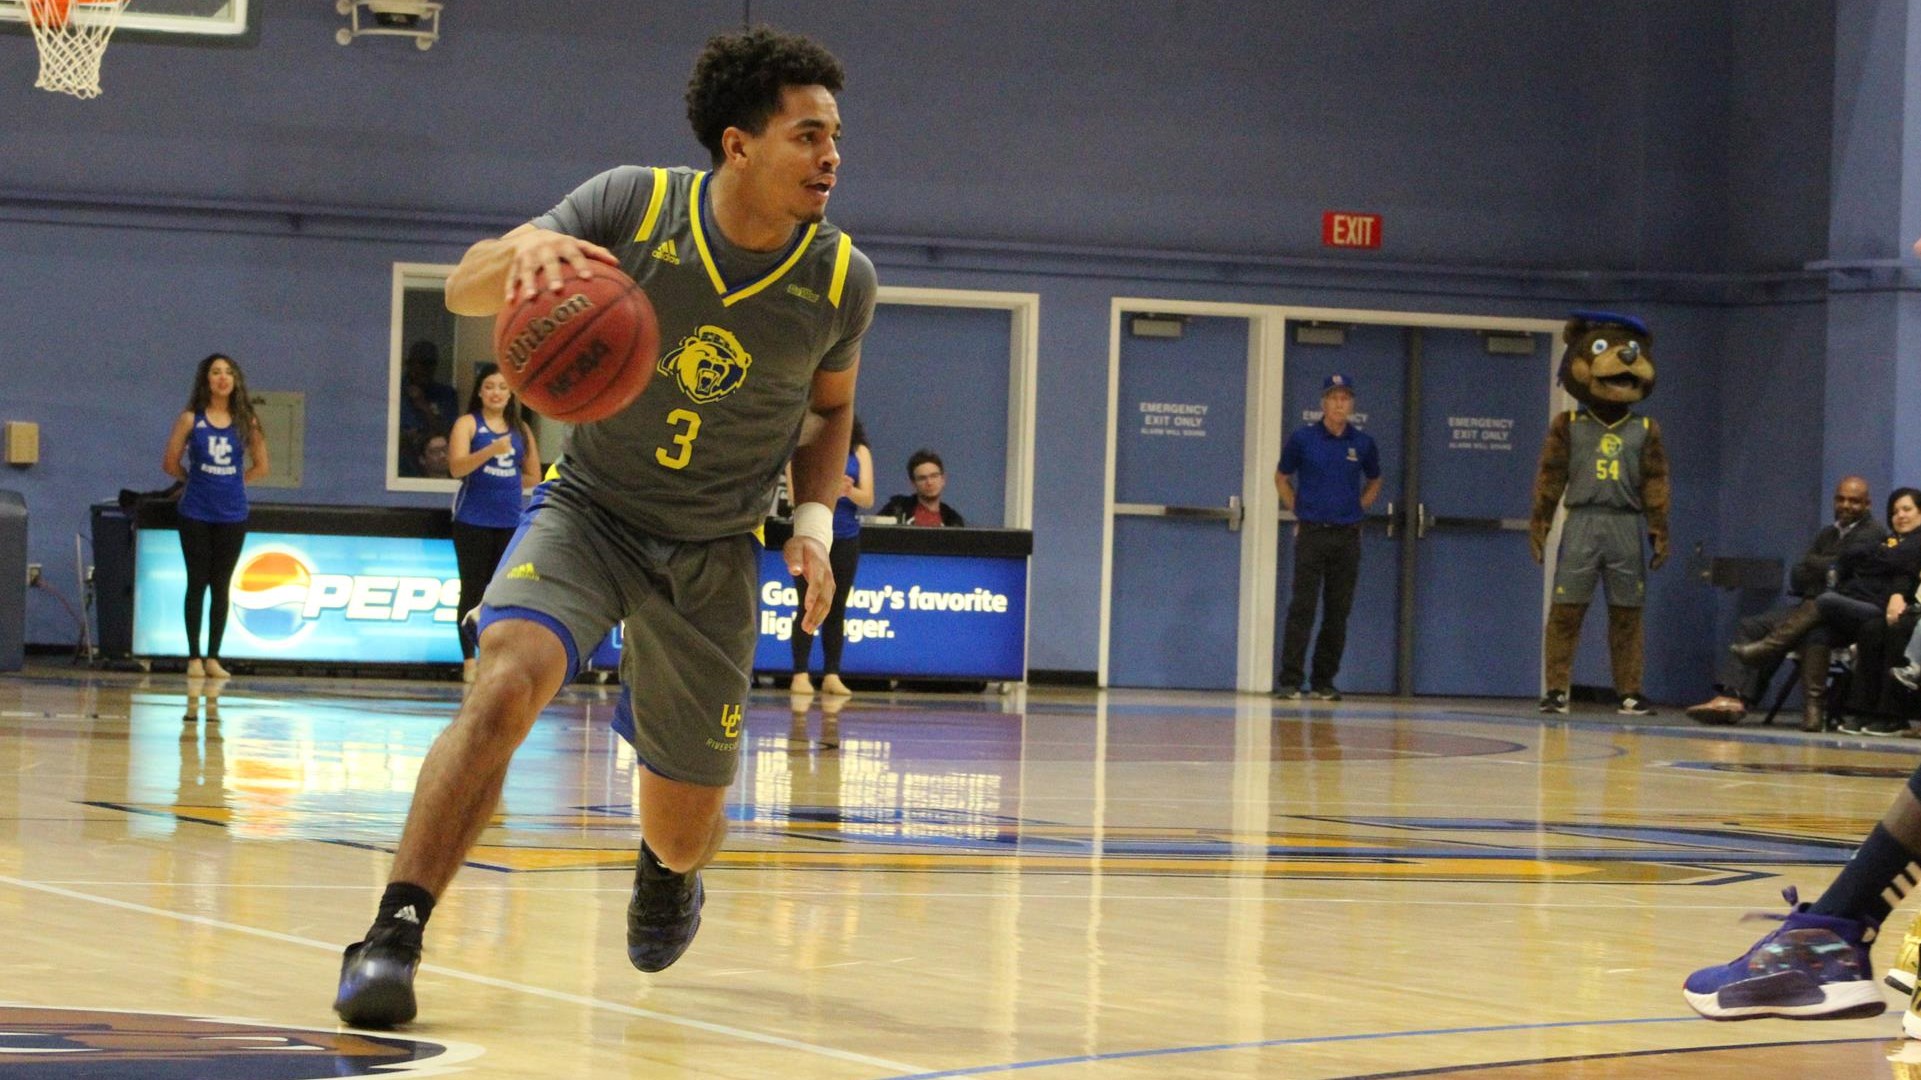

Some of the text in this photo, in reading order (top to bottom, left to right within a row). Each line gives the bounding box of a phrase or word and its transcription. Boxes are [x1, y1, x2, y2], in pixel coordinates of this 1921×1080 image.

[1333, 214, 1375, 245] EXIT
[505, 294, 593, 373] Wilson
[1140, 402, 1208, 415] EMERGENCY
[1145, 415, 1203, 427] EXIT ONLY
[1302, 410, 1369, 423] EMNCY
[1448, 417, 1514, 429] EMERGENCY
[208, 435, 232, 465] UC
[656, 408, 702, 470] 3
[1453, 429, 1509, 441] EXIT ONLY
[1596, 459, 1619, 480] 54
[302, 573, 462, 623] PEPS
[761, 580, 1008, 614] Gaay's favorite
[720, 703, 742, 738] UC
